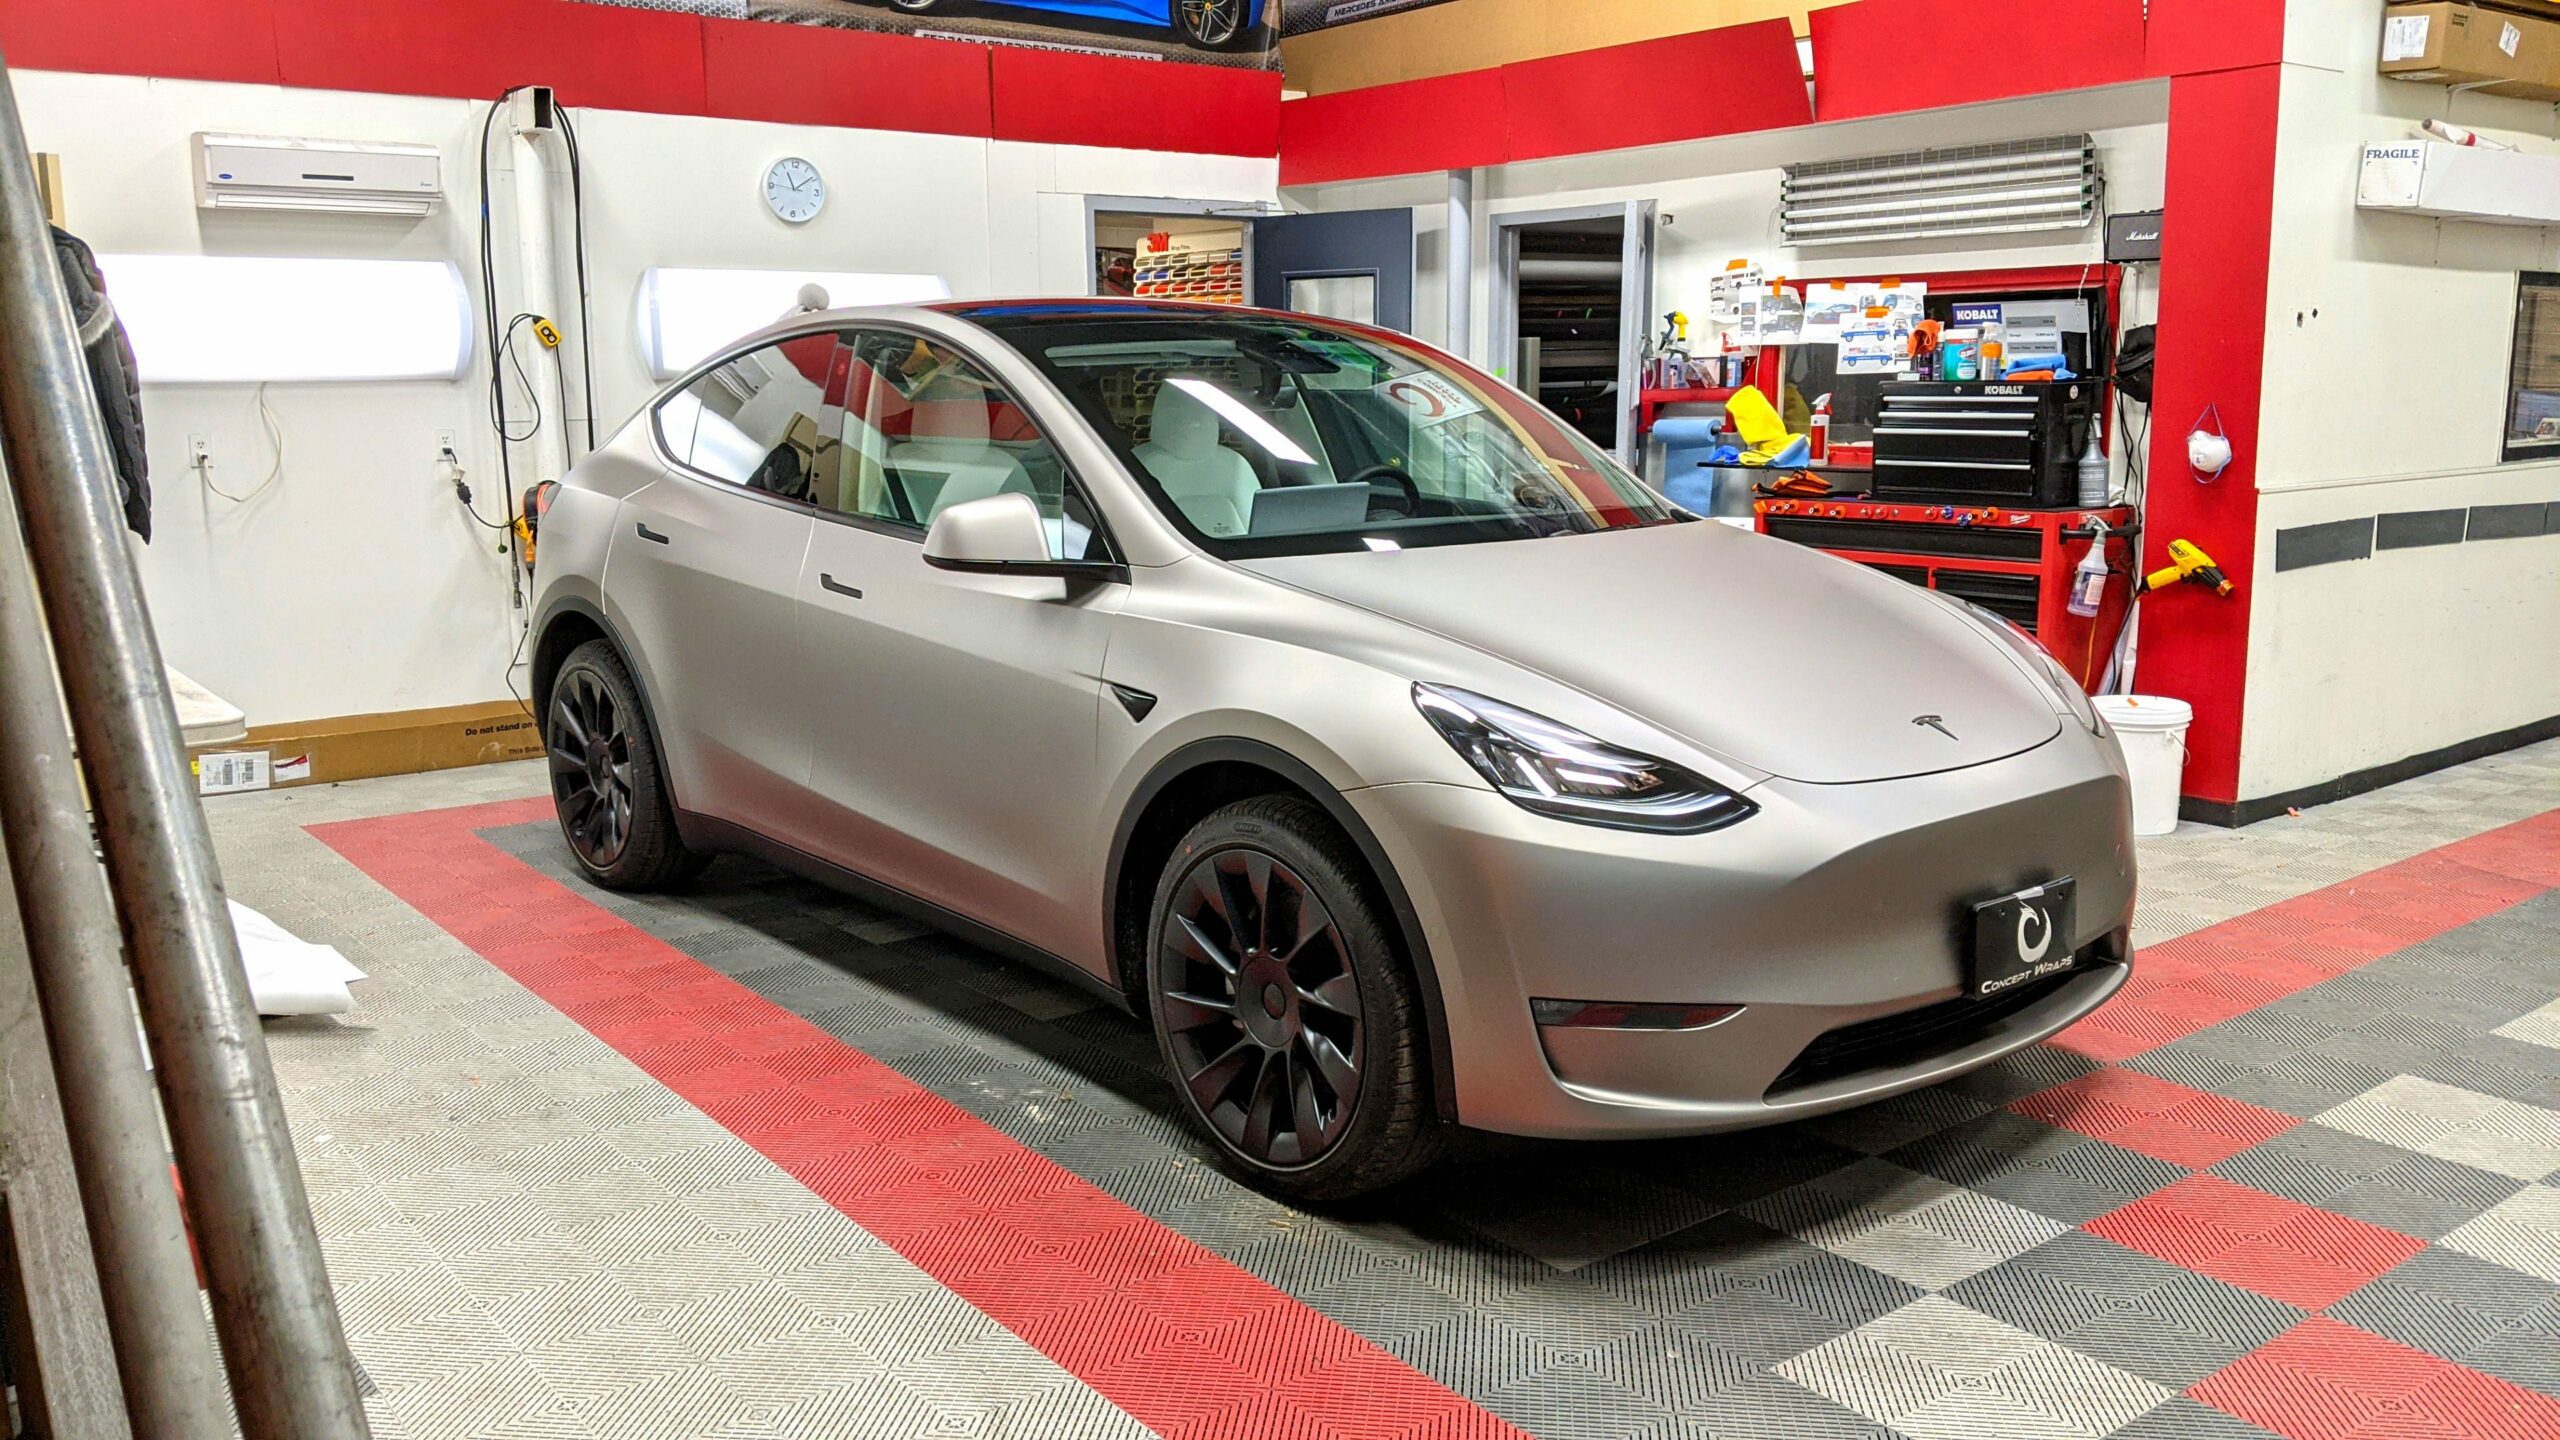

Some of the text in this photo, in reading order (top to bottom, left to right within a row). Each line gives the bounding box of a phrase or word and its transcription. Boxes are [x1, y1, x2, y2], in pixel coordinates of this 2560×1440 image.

[1334, 0, 1377, 16] MERCEDES
[2366, 149, 2420, 159] FRAGILE
[791, 161, 800, 169] 12
[768, 182, 775, 190] 9
[813, 189, 820, 197] 3
[790, 210, 796, 218] 6
[2125, 230, 2159, 241] Marshall
[1147, 231, 1169, 253] 3M
[1956, 309, 1999, 321] KOBALT
[1984, 385, 2024, 395] KOBALT
[465, 721, 533, 737] Do not stand on
[508, 747, 523, 755] This
[524, 745, 540, 753] Side
[1981, 955, 2073, 994] CONCEPT WRAPS
